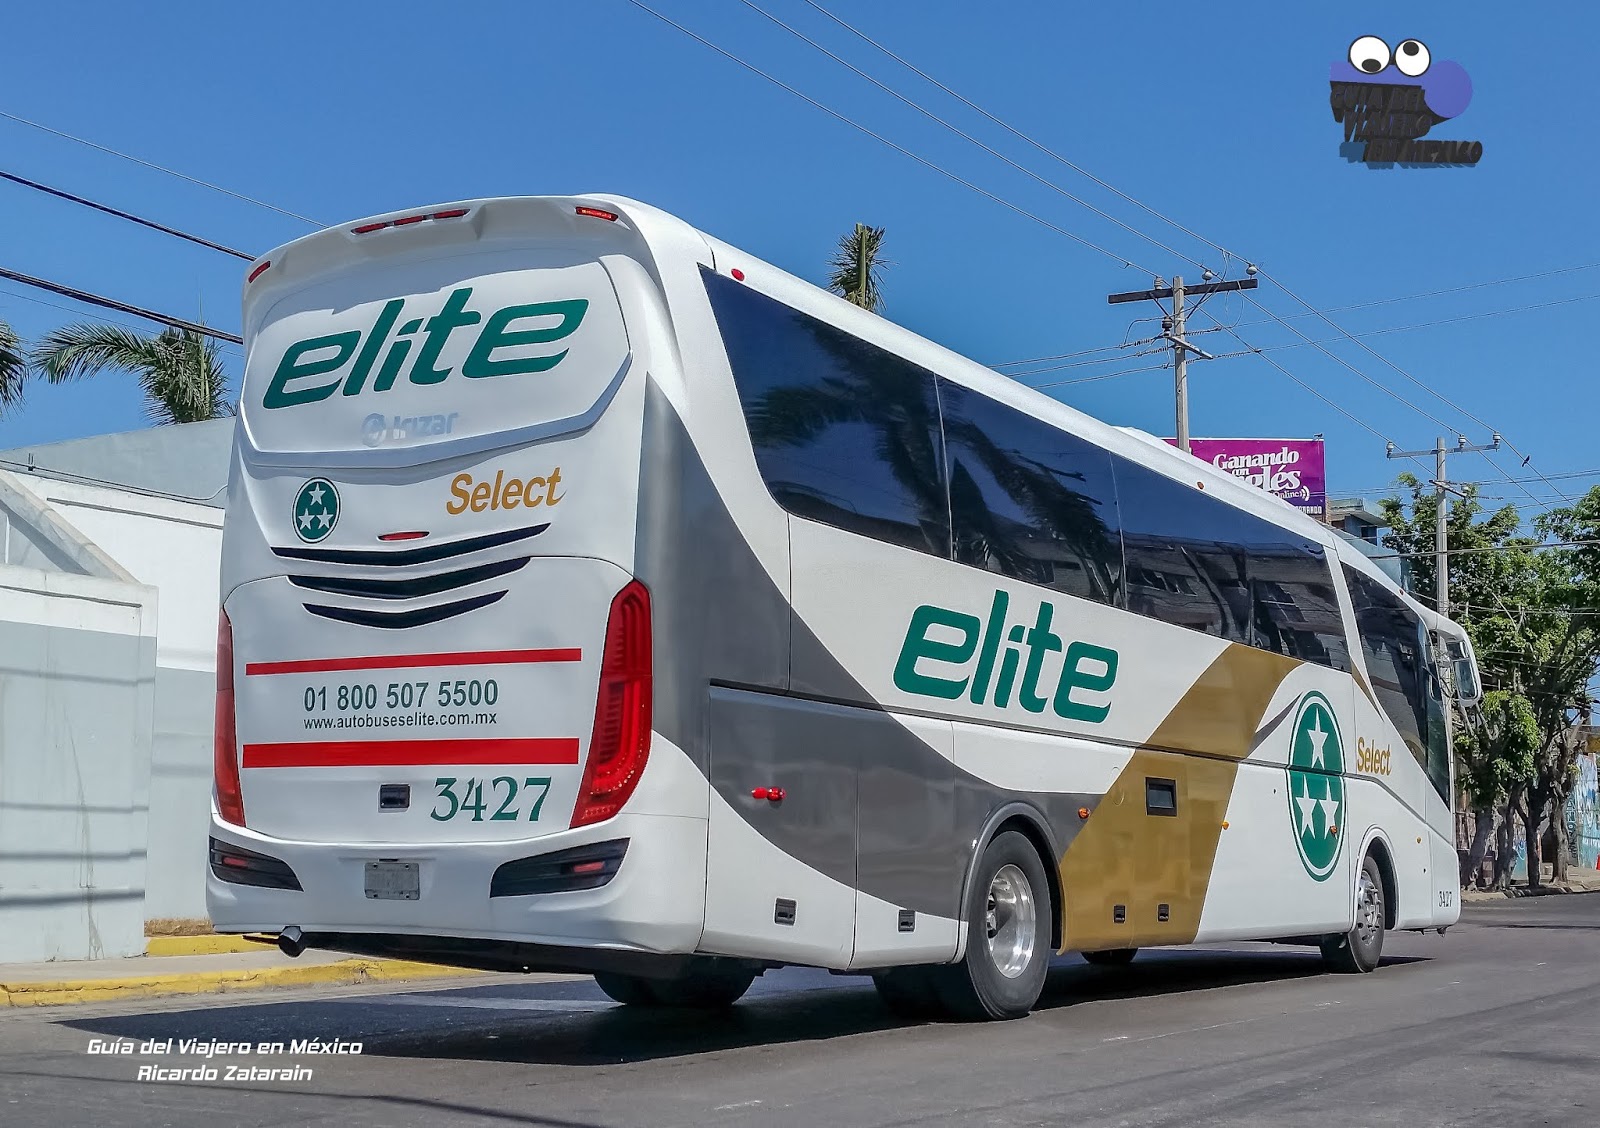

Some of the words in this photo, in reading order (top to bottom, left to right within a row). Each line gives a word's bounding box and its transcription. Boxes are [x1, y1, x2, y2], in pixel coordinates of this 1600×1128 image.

[262, 287, 589, 409] elite
[1213, 447, 1300, 470] Ganando
[446, 467, 567, 515] Select
[893, 589, 1119, 723] elite
[304, 686, 327, 711] 01
[337, 684, 377, 711] 800
[386, 682, 429, 708] 507
[438, 679, 498, 707] 5500
[303, 712, 497, 729] www.autobuseselite.com.mx
[1357, 736, 1391, 776] Select
[430, 776, 552, 822] 3427
[1438, 890, 1453, 907] 3427
